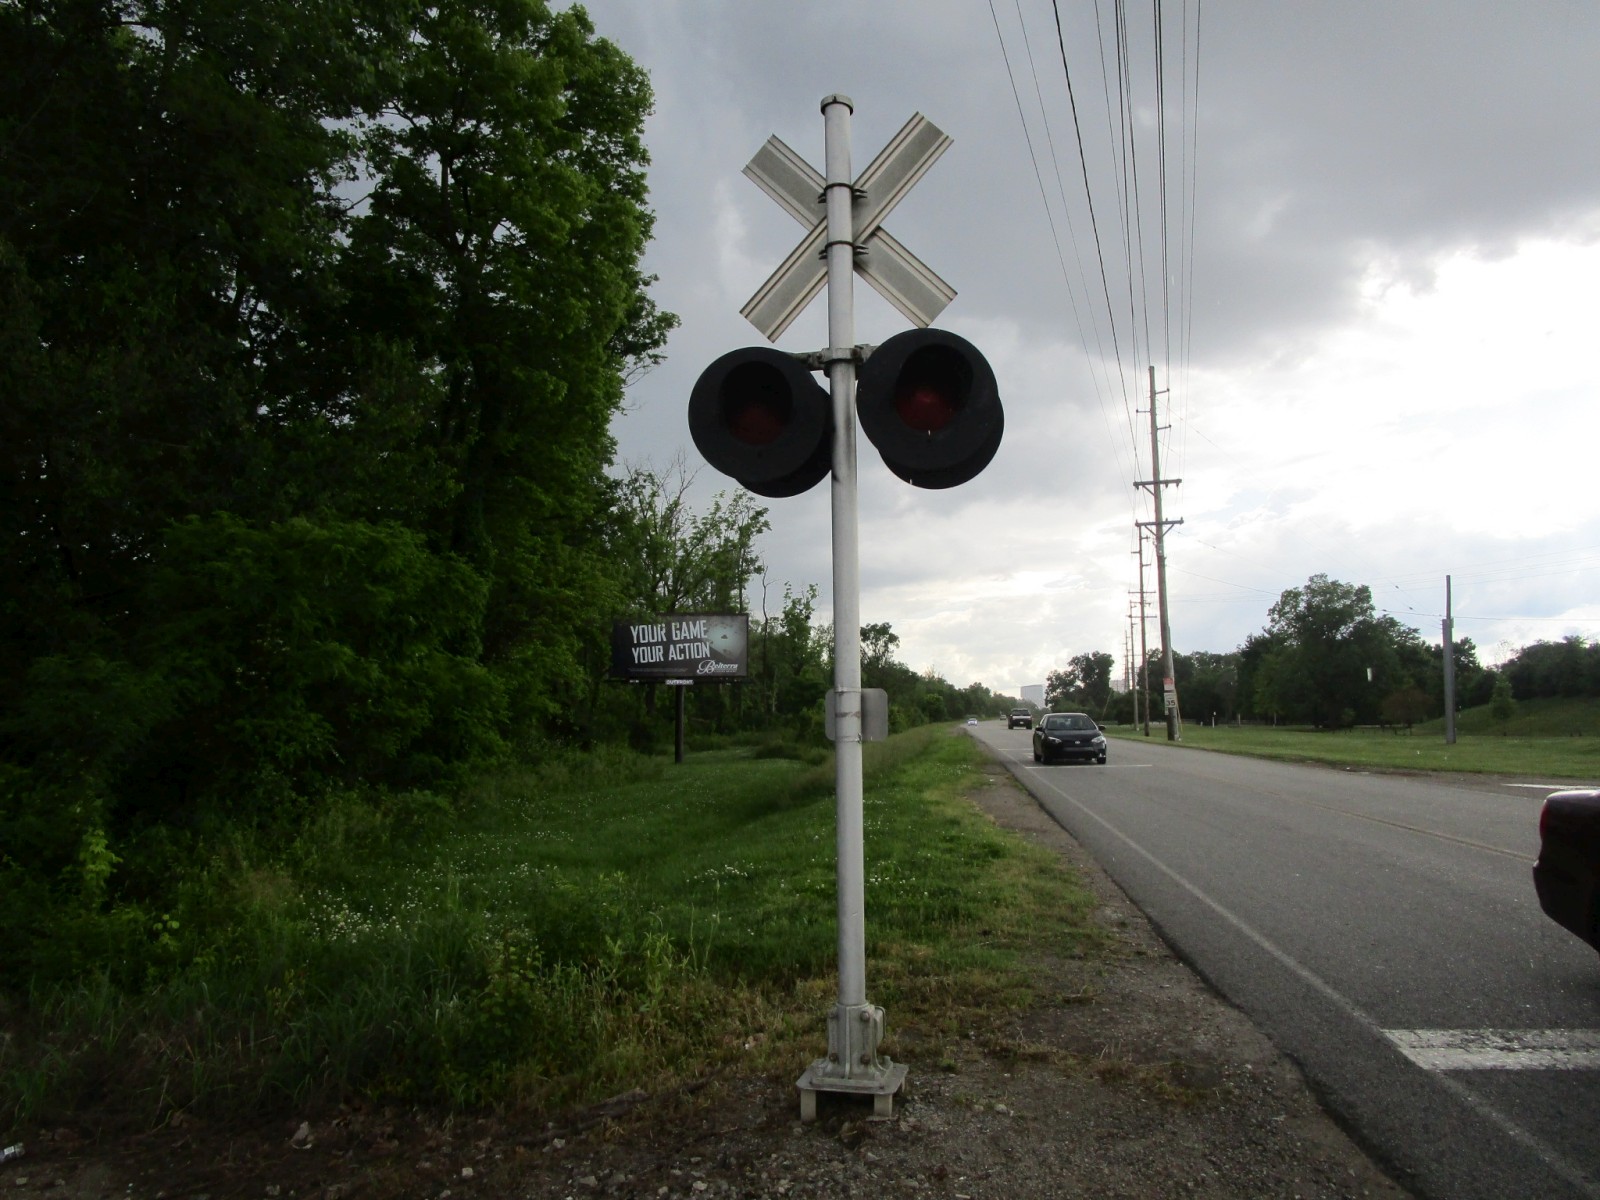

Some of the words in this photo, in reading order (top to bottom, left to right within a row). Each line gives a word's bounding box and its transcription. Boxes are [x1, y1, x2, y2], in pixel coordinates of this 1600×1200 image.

[630, 623, 667, 644] YOUR
[671, 620, 708, 641] GAME
[631, 645, 664, 664] YOUR
[668, 641, 711, 661] ACTION
[696, 659, 739, 675] Belterra
